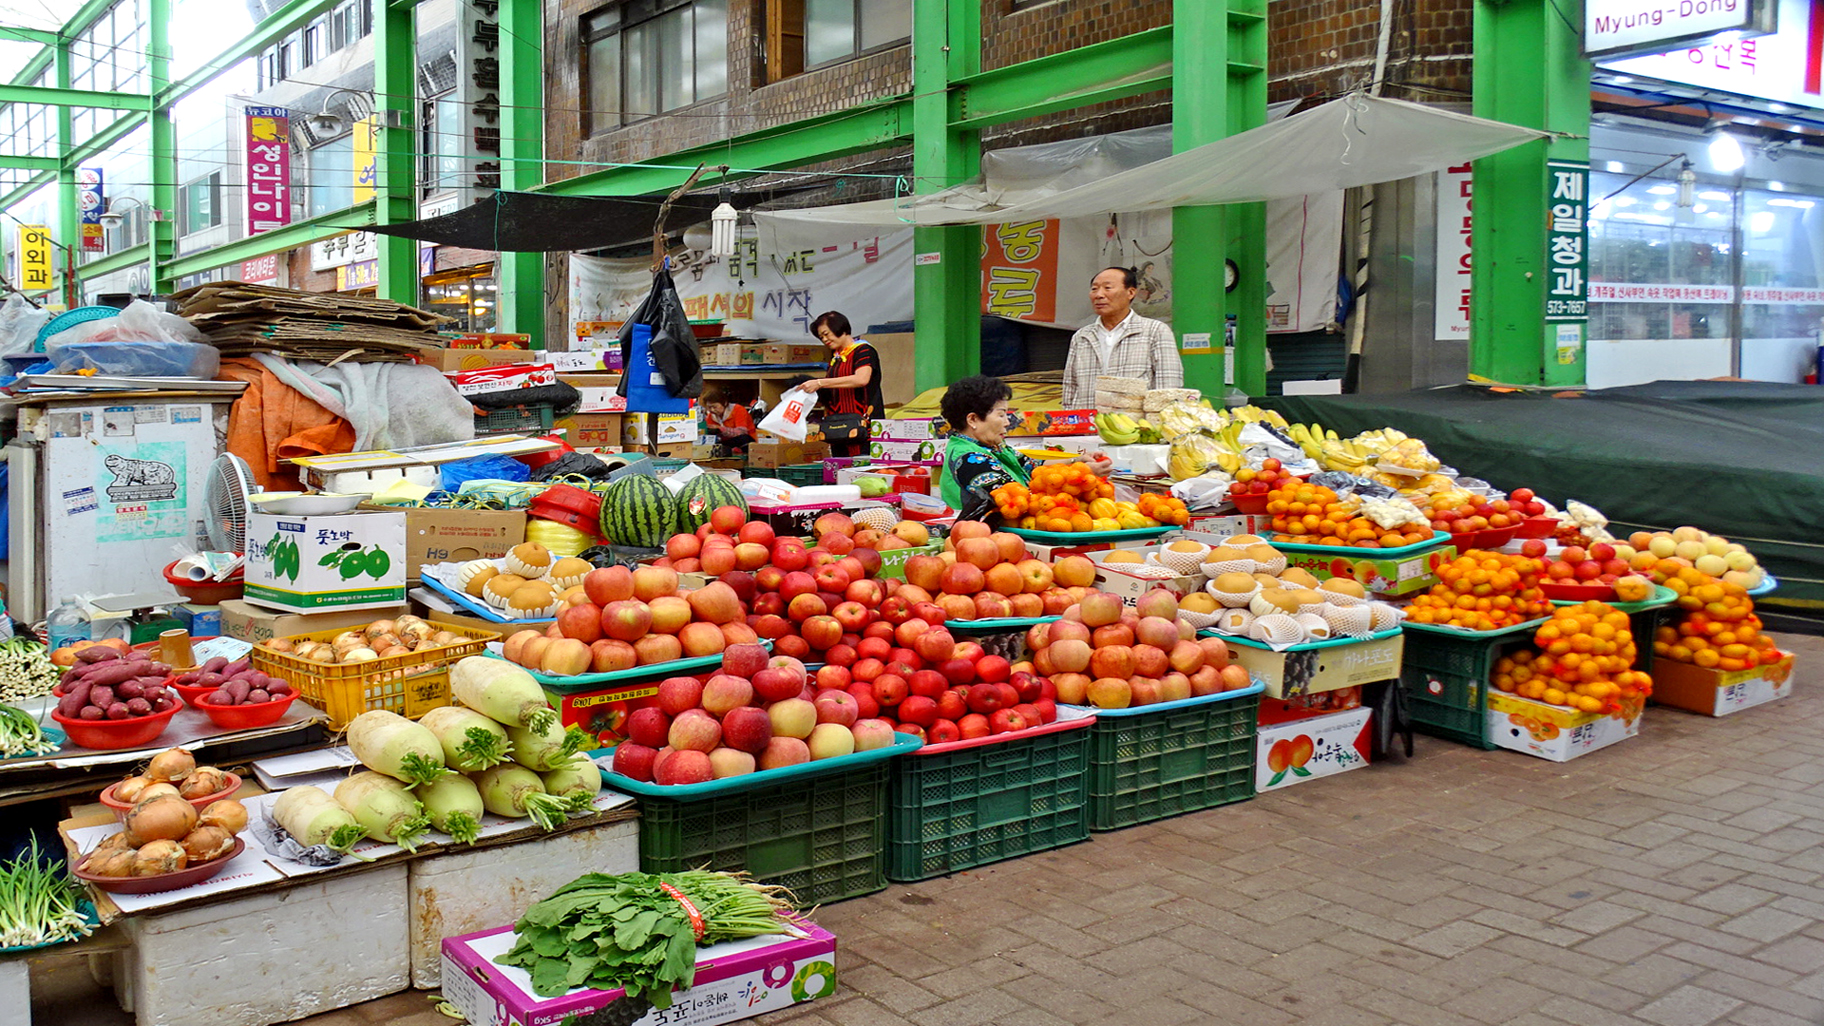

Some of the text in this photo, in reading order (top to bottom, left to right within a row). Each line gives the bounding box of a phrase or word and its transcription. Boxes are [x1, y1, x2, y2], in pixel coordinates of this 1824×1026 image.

[1594, 0, 1738, 34] Myung-Dong
[1551, 171, 1584, 296] 제일청과
[244, 256, 276, 279] 코리아타운
[762, 287, 812, 334] 시작
[1547, 300, 1586, 314] 573-7657
